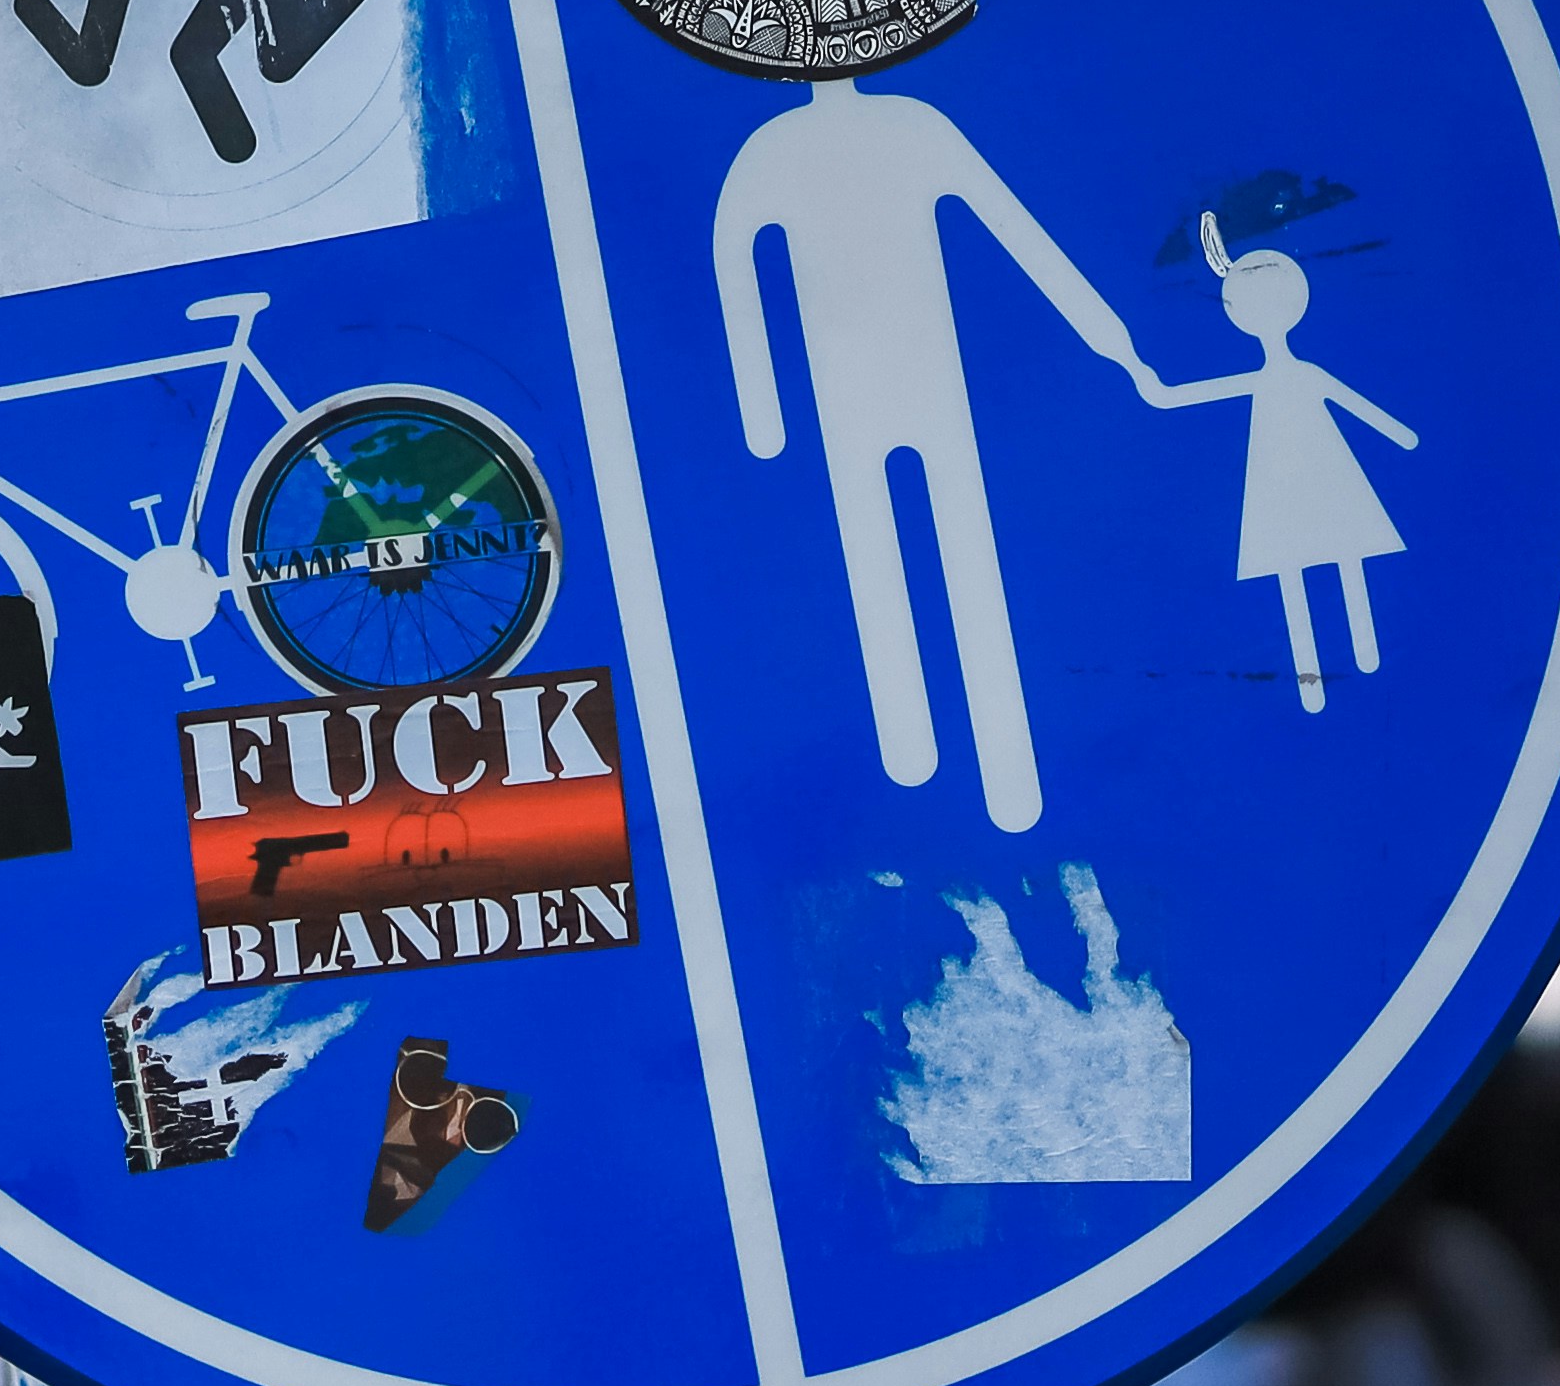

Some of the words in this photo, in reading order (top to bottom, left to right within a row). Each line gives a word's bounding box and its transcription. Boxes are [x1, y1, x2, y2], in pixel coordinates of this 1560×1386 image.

[243, 544, 351, 583] WAAR
[366, 539, 403, 568] IS
[183, 679, 613, 820] FUCK
[202, 882, 631, 985] BLANDEN
